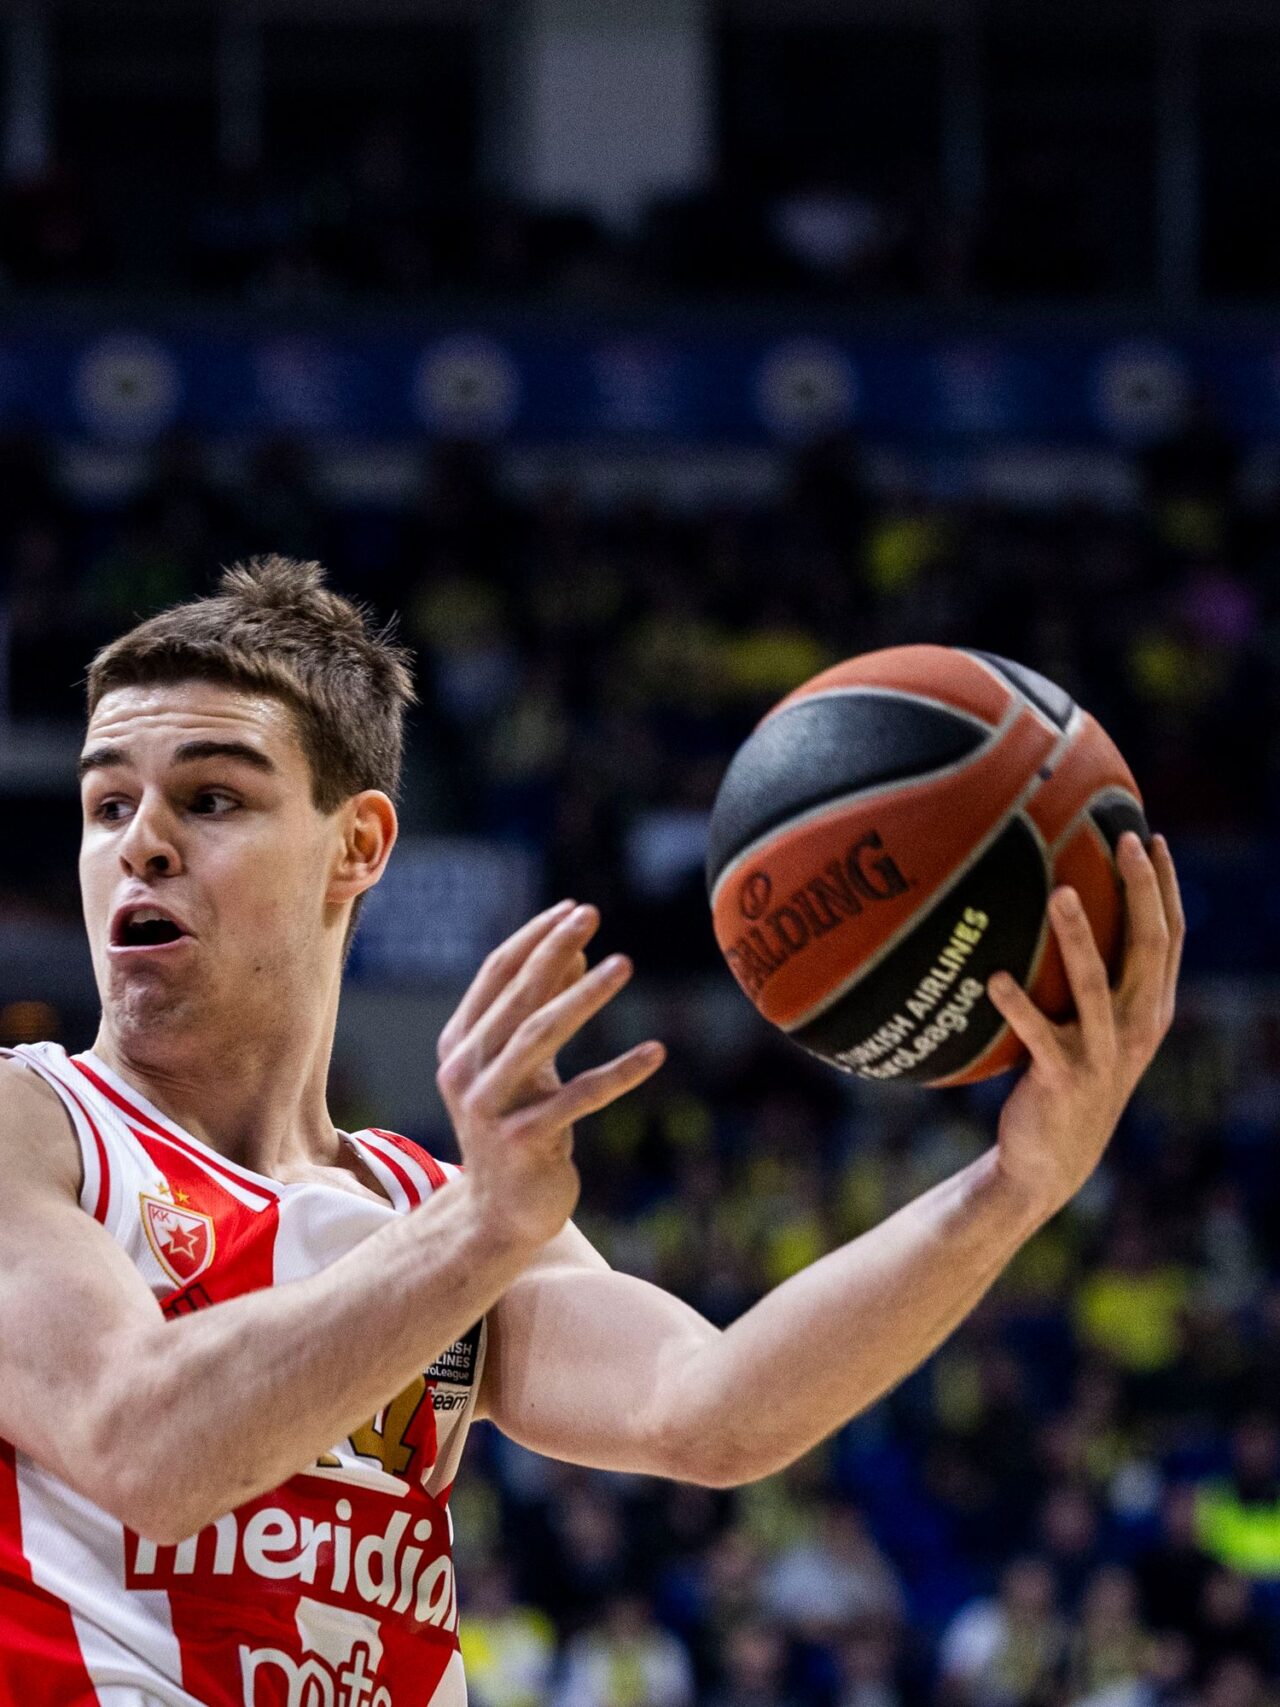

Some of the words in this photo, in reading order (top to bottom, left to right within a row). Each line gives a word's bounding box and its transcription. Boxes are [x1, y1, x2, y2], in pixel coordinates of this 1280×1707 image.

[728, 829, 910, 990] ALDING
[905, 906, 989, 1019] AIRLINES
[424, 1365, 470, 1381] roLeague
[436, 1353, 470, 1369] LINES
[317, 1374, 425, 1476] 4
